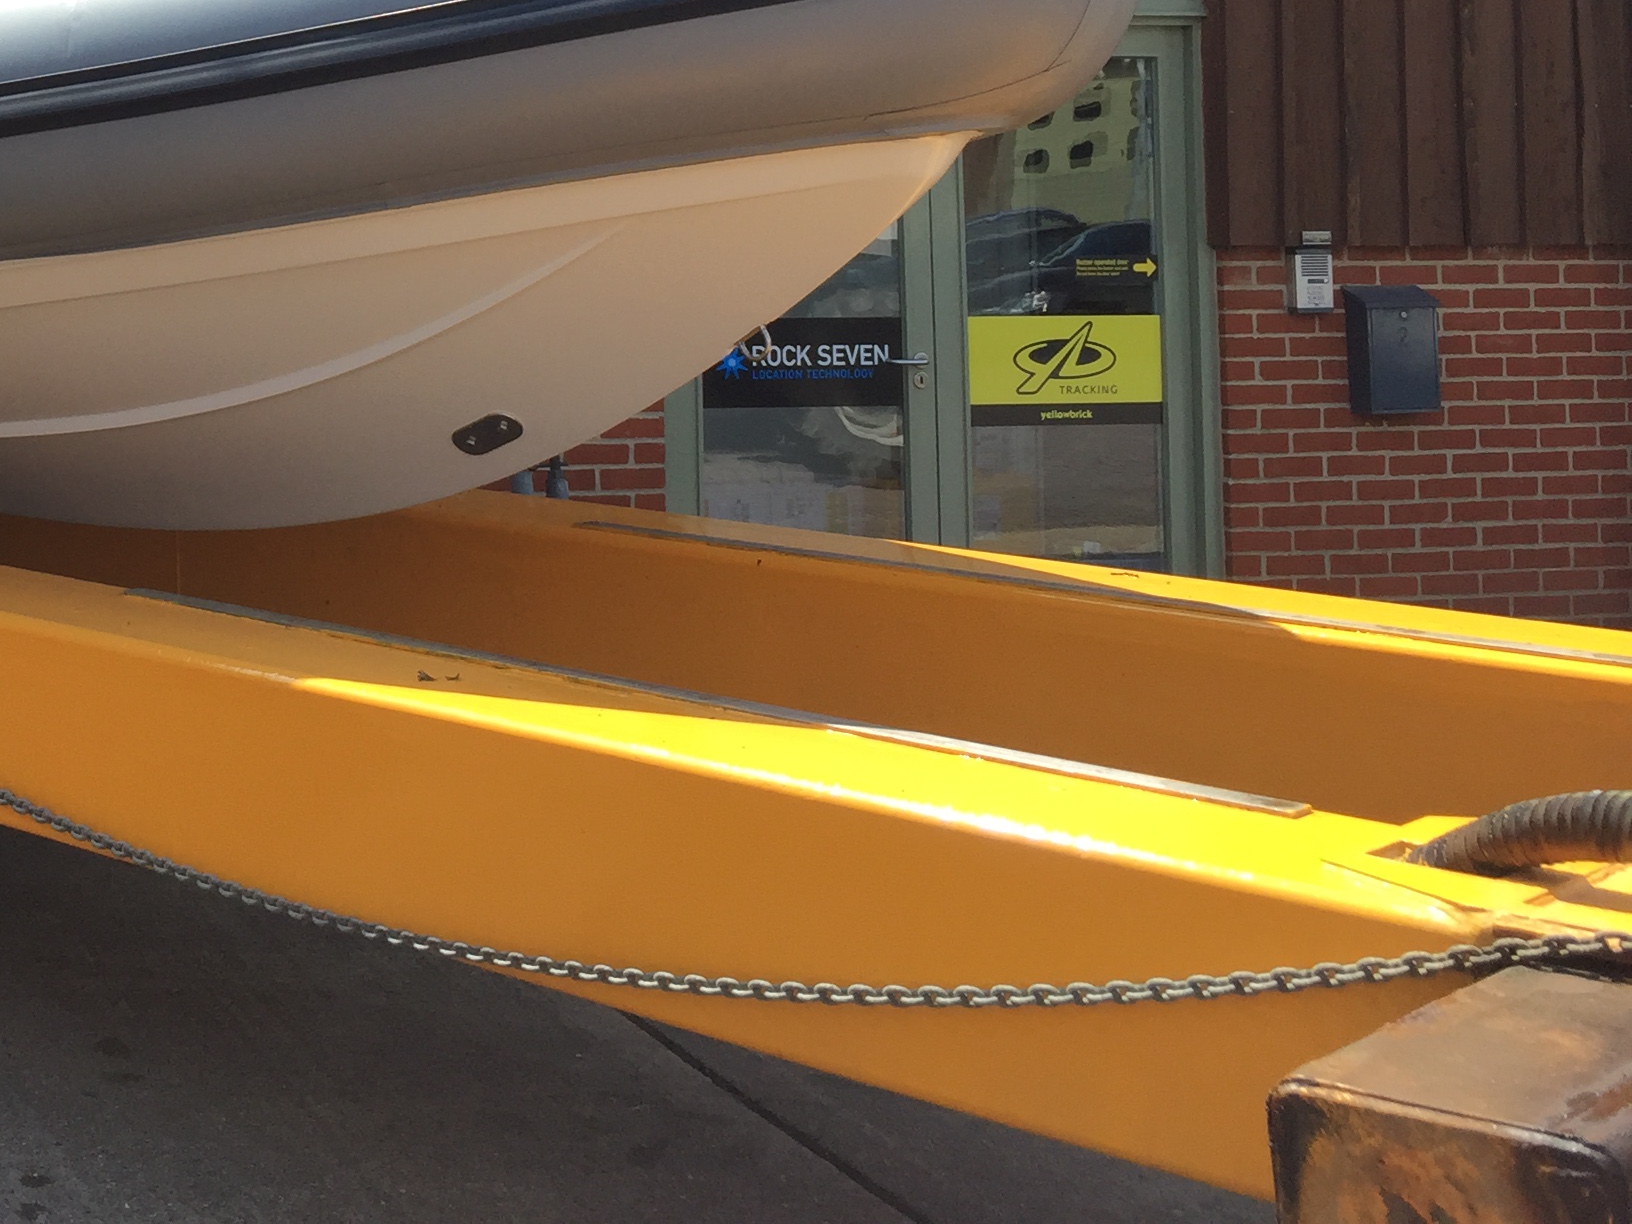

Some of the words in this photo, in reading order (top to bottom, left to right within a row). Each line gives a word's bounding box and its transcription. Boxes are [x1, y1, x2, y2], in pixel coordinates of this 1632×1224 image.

[751, 344, 812, 367] ROCK
[817, 344, 889, 367] SEVEN
[752, 369, 803, 380] LOCATION
[808, 368, 875, 379] TECHNOLOGY
[1059, 384, 1118, 395] TRACKING
[1040, 408, 1093, 421] yellowbrick
